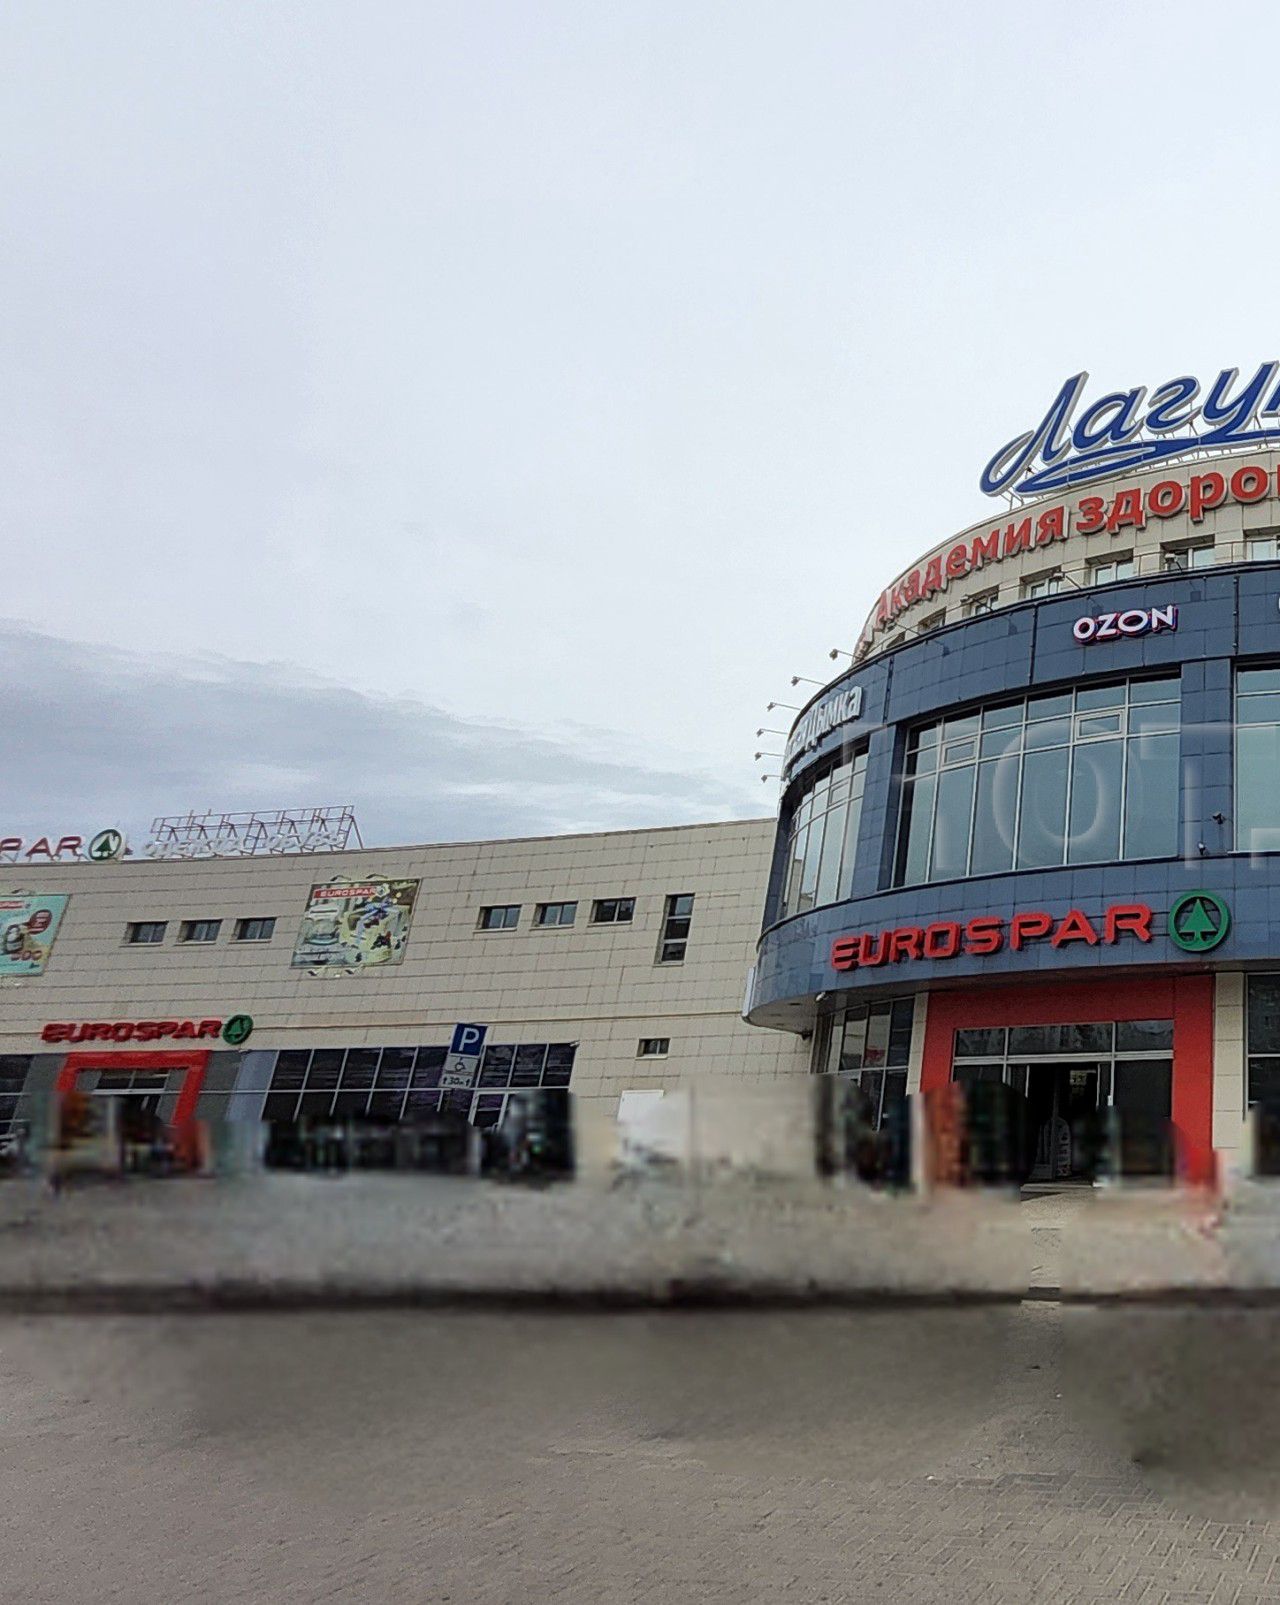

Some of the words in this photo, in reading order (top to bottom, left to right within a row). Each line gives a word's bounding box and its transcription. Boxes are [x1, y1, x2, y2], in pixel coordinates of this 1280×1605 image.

[1072, 604, 1179, 645] OZON
[829, 902, 1154, 972] EUROSPAR
[41, 1020, 222, 1042] EUROSPAR
[458, 1027, 480, 1052] P
